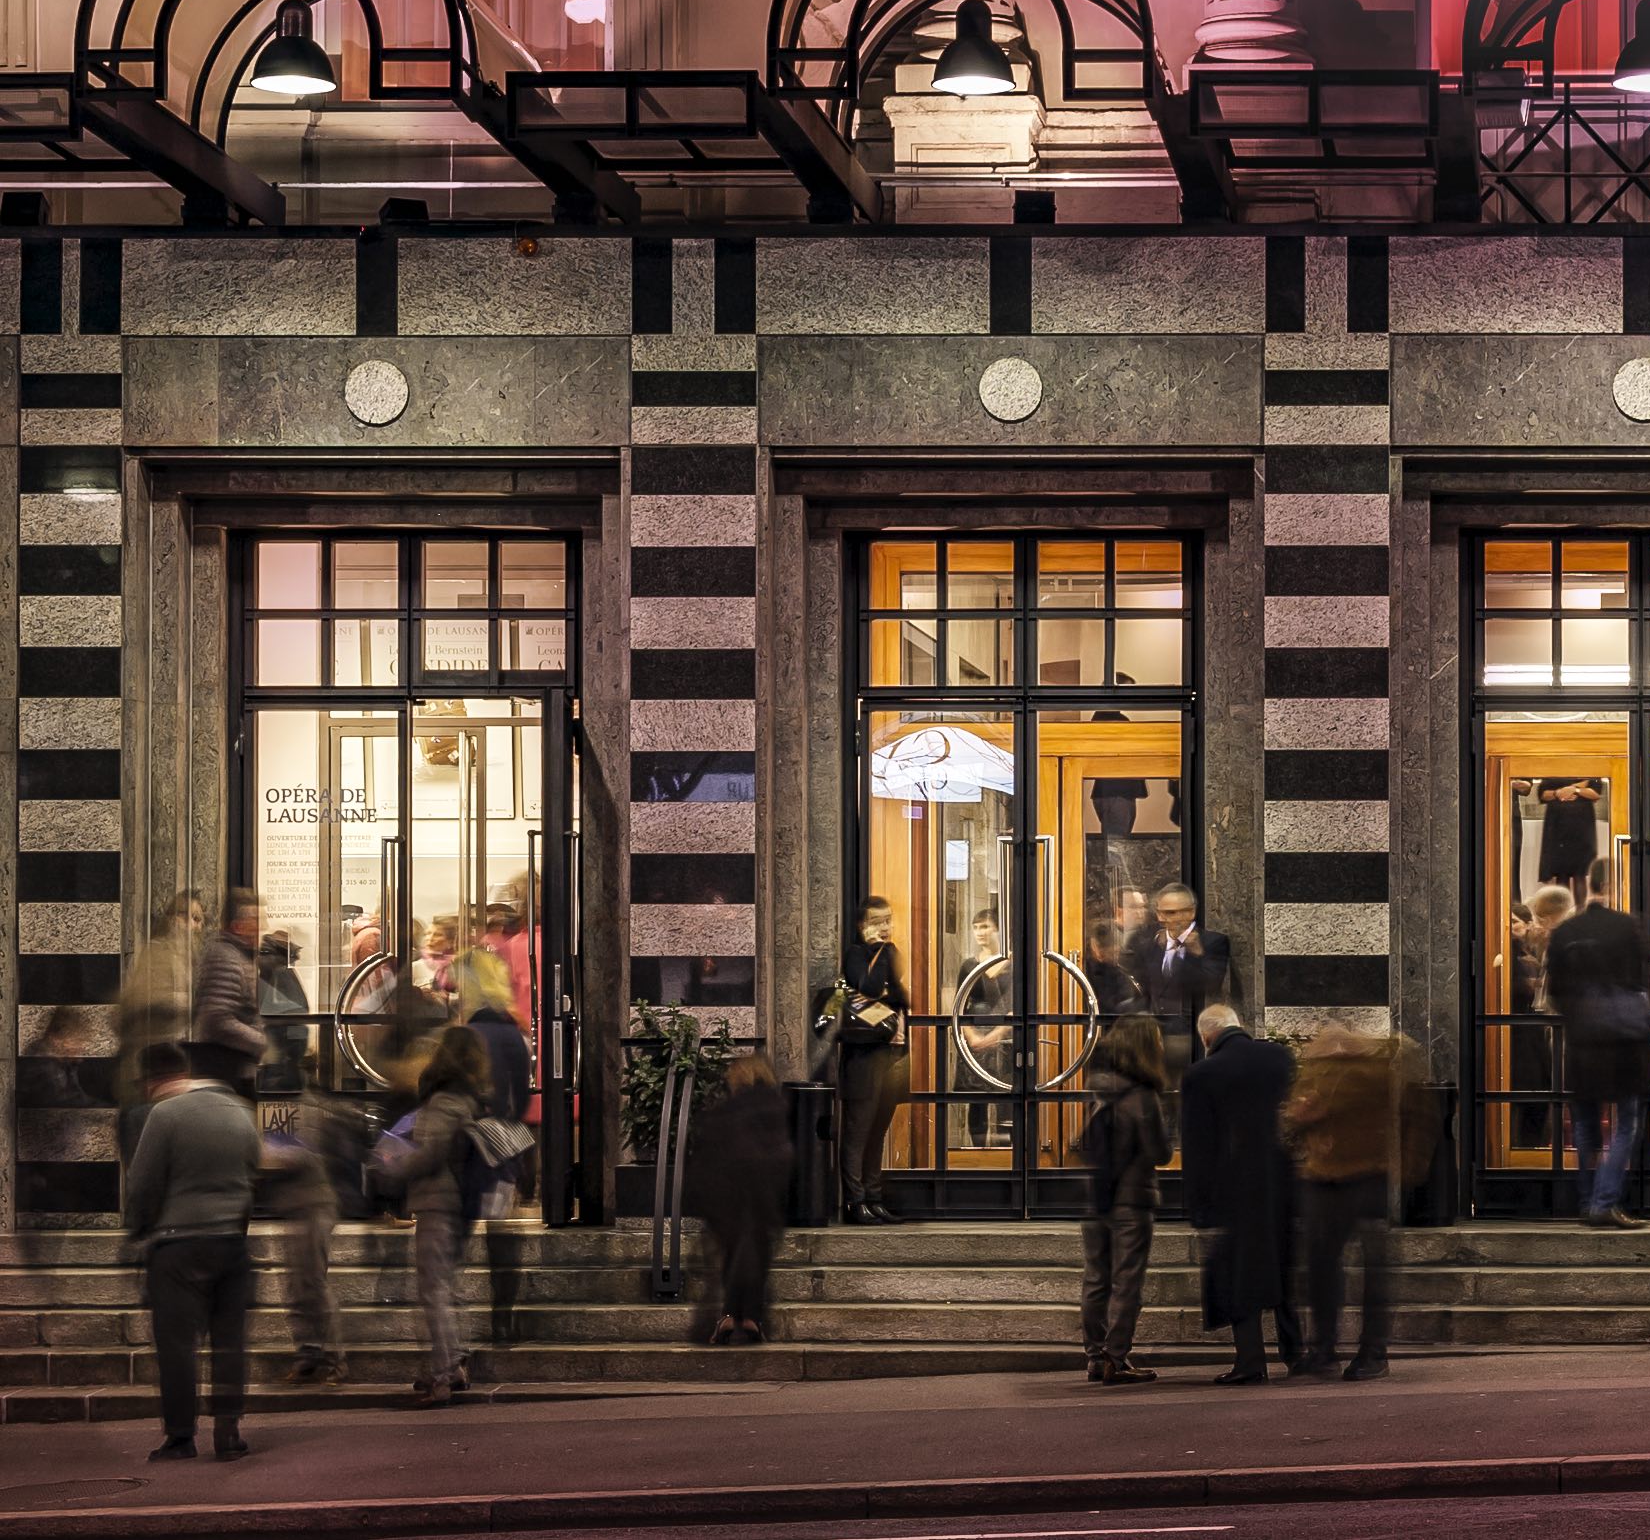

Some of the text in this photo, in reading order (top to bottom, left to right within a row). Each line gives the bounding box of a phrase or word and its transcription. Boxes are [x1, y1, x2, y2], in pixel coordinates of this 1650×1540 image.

[446, 627, 488, 635] LAUSAN
[536, 626, 564, 636] OPÉR
[435, 646, 483, 655] Bernstein
[538, 646, 565, 655] Leon
[265, 784, 367, 803] OPÉRA DE
[266, 808, 378, 823] LAUSANNE
